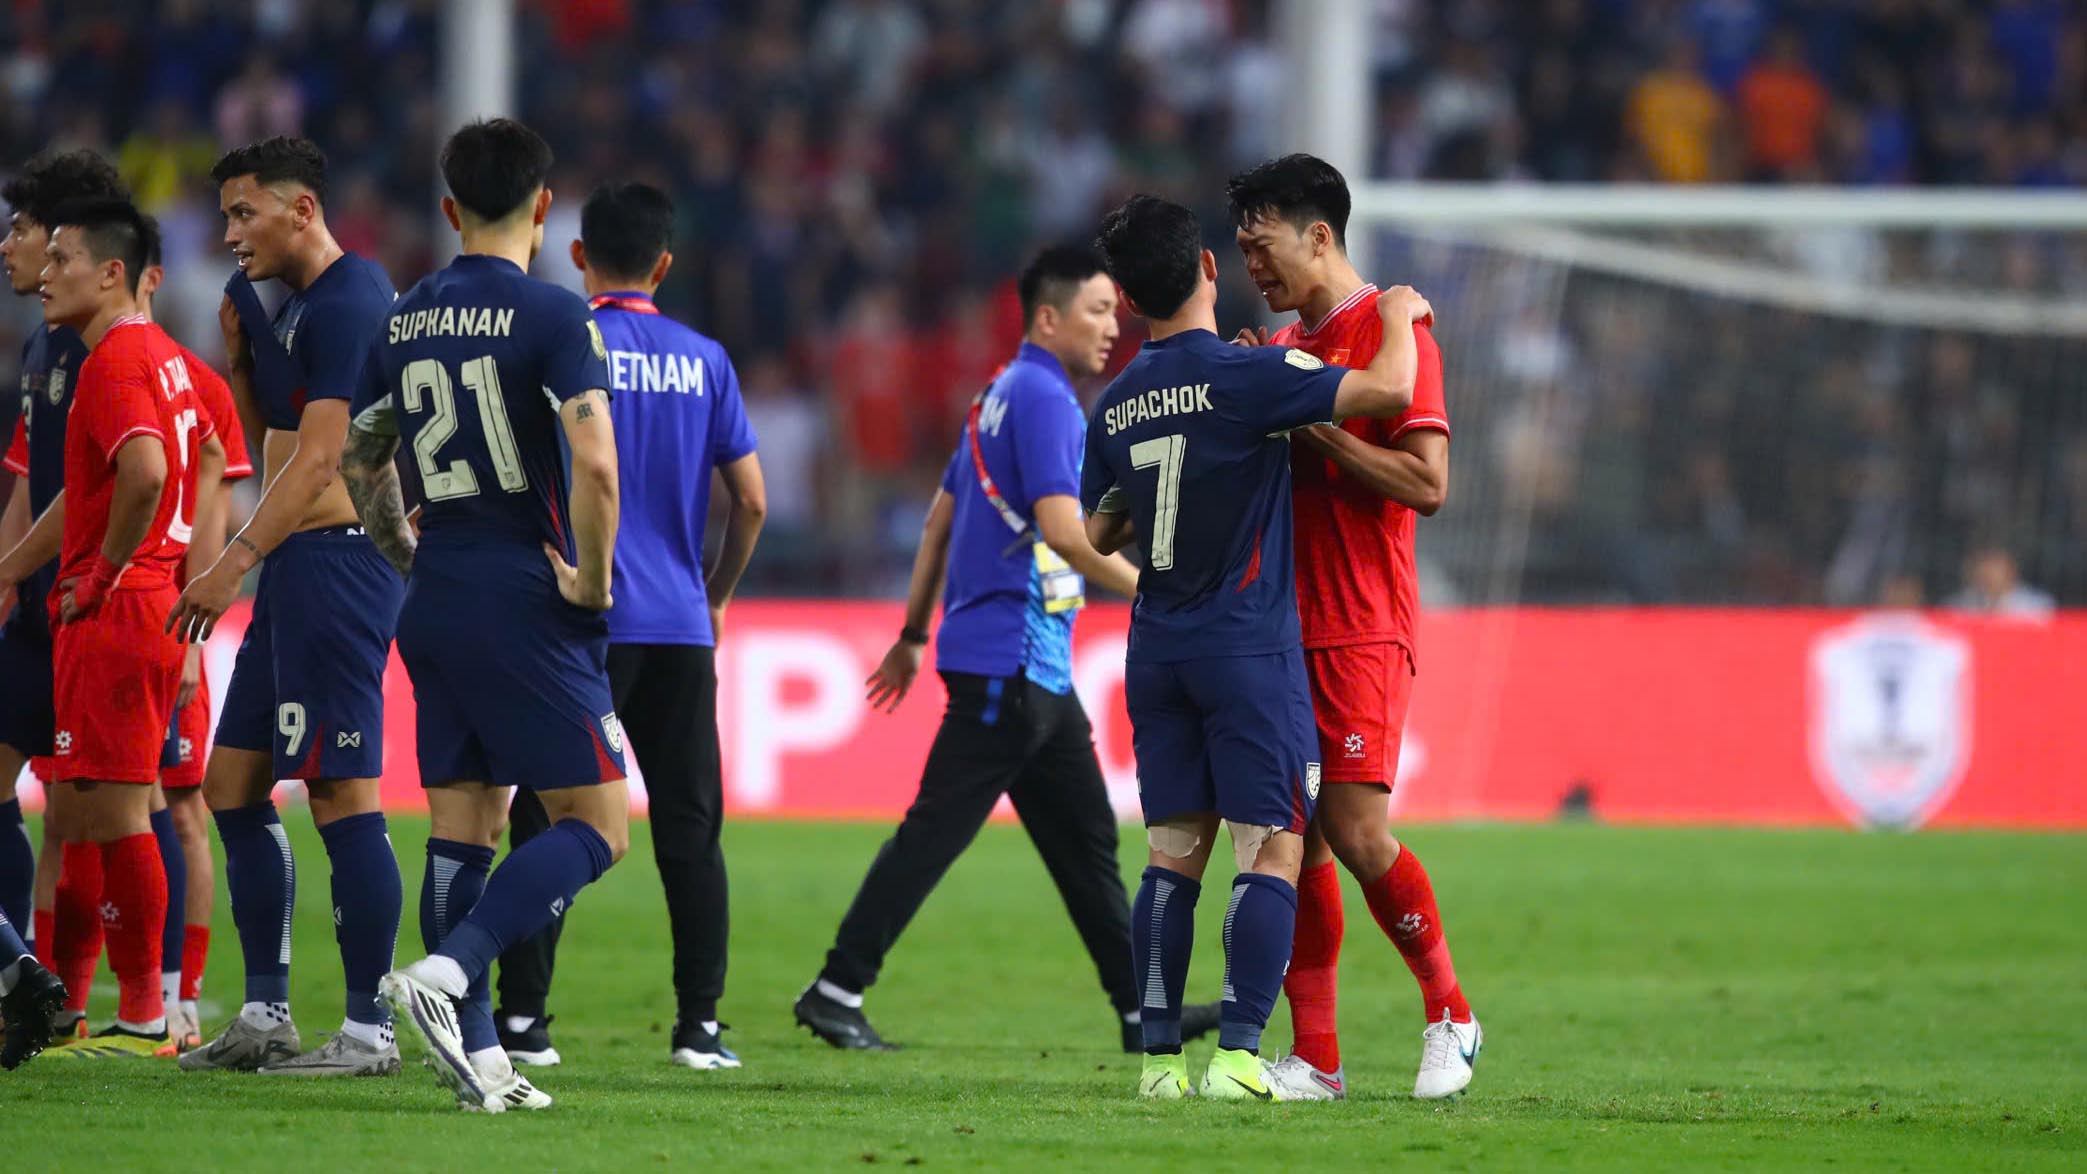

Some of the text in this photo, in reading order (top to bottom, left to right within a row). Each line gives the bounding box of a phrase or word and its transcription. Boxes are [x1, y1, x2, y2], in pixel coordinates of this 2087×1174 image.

[389, 307, 514, 344] SUPHANAN
[606, 350, 703, 396] ETNAM
[402, 355, 529, 502] 21
[1105, 384, 1213, 436] SUPACHOK
[1129, 434, 1187, 571] 7
[278, 702, 306, 756] 9
